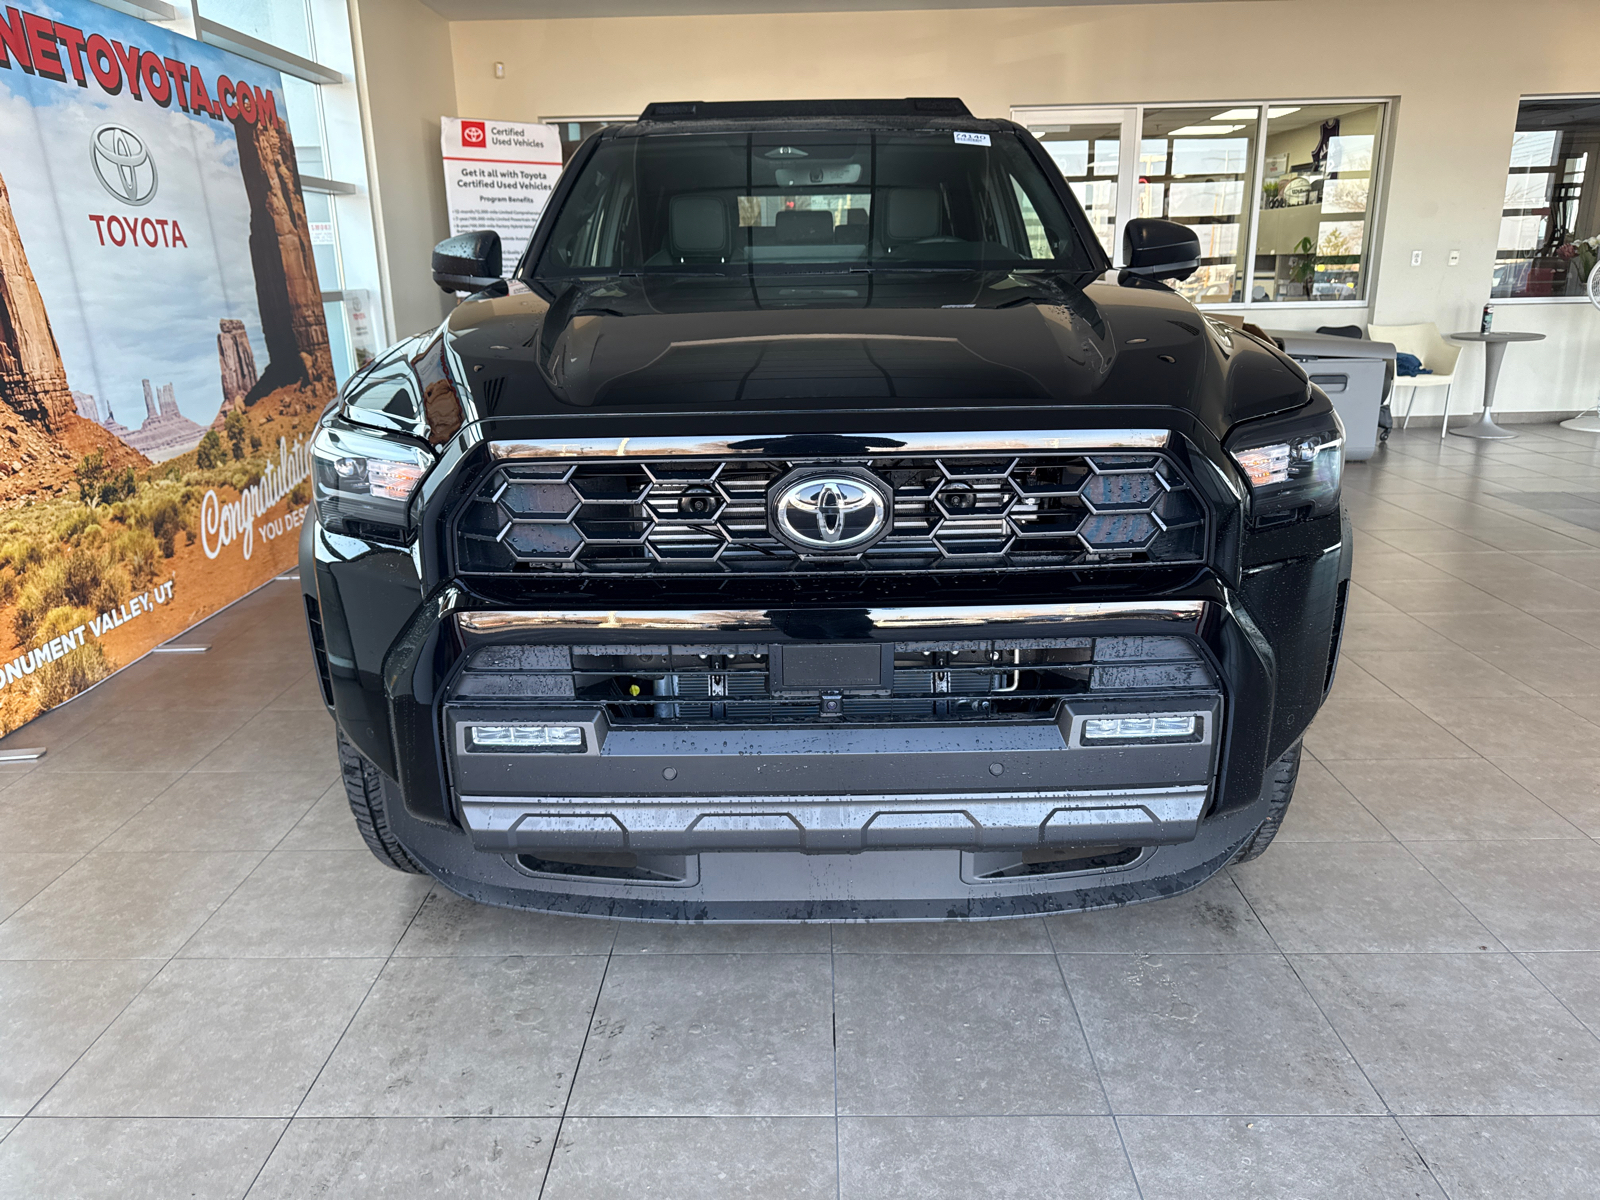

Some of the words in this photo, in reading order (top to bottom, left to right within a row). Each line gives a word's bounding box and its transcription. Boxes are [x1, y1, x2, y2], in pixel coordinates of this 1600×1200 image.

[491, 127, 525, 137] Certified
[492, 138, 512, 146] Used
[513, 138, 544, 148] Vehicles
[461, 168, 477, 177] Get
[478, 169, 486, 178] it
[487, 169, 498, 178] all
[500, 170, 519, 179] with
[520, 171, 547, 182] Toyota
[457, 179, 495, 189] Certified
[496, 181, 517, 190] Used
[519, 182, 552, 191] Vehicles
[479, 195, 507, 204] Program
[508, 196, 534, 204] Benefits
[89, 214, 188, 249] TOYOTA
[258, 517, 283, 543] YOU
[88, 592, 155, 638] VALLEY,
[154, 580, 174, 606] UT
